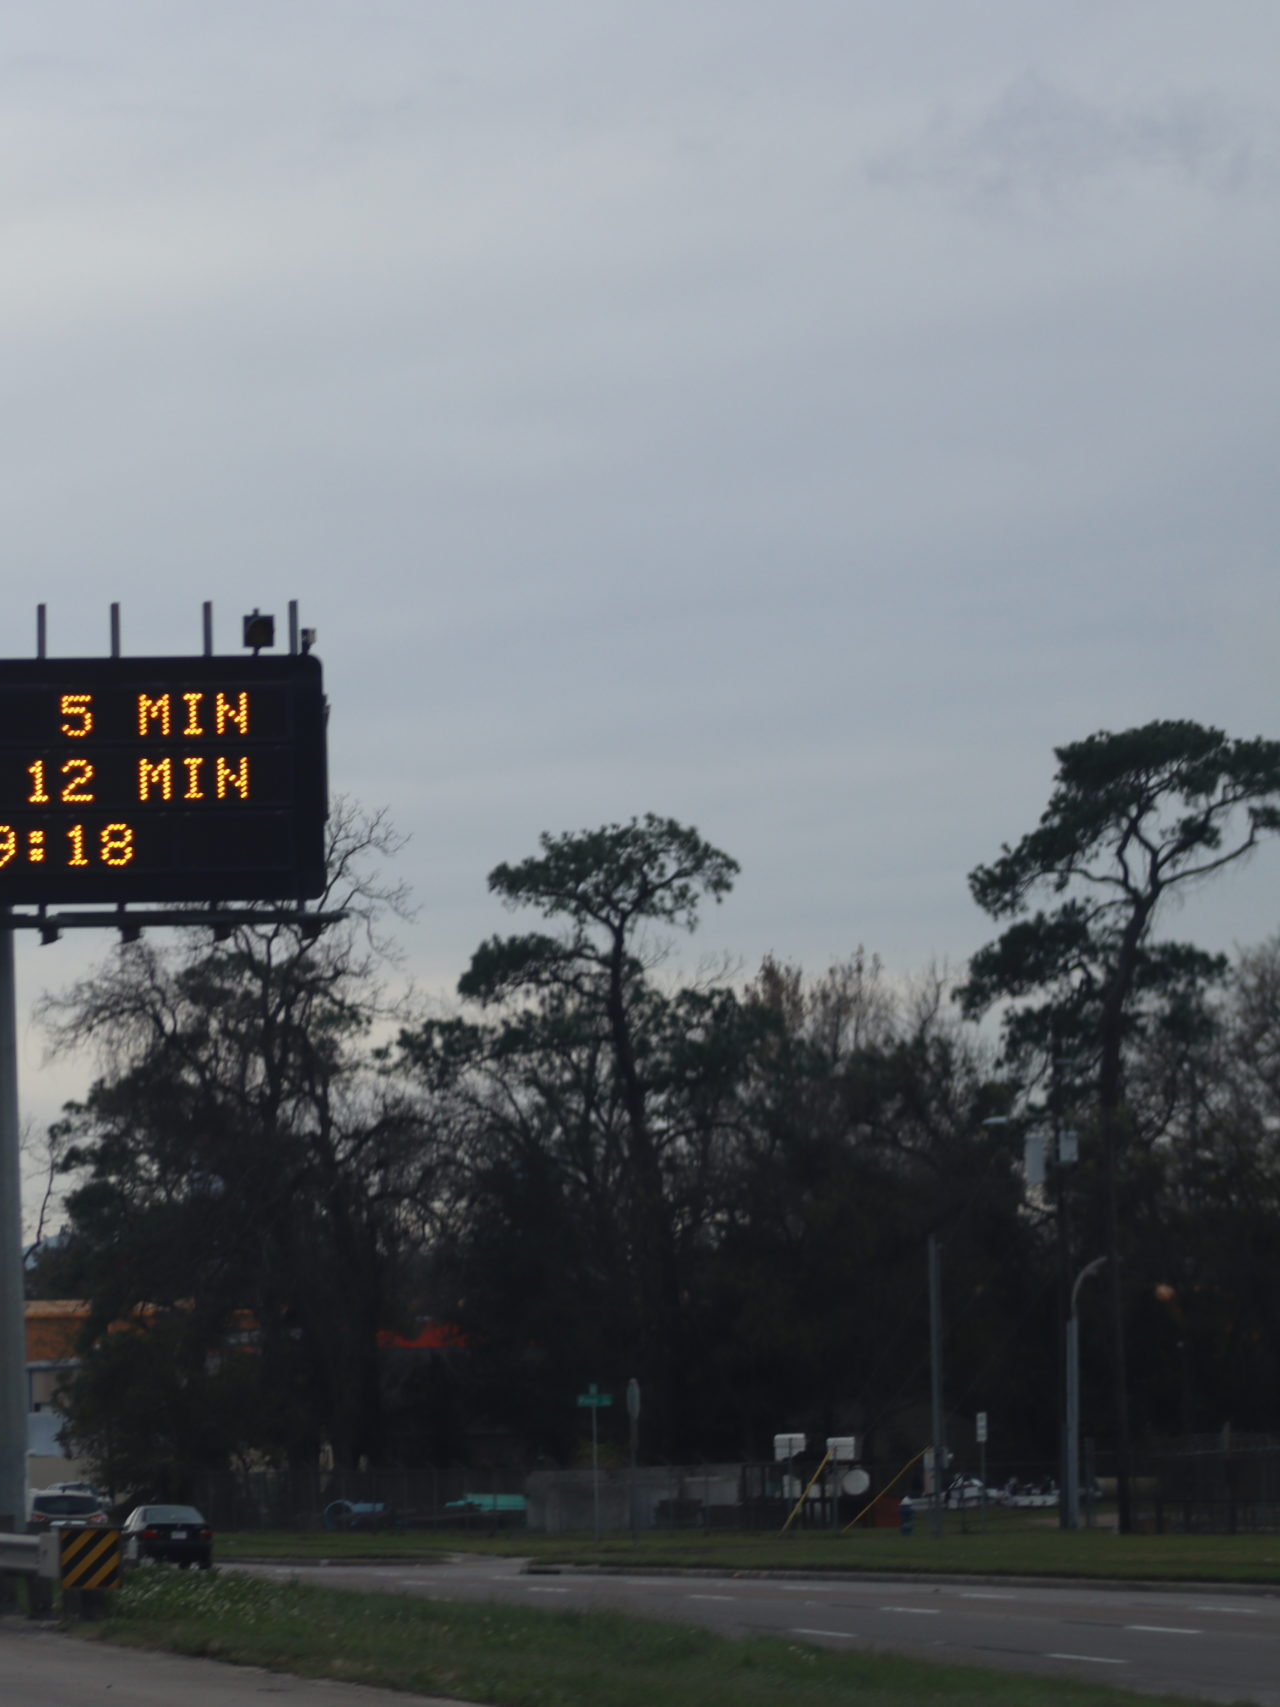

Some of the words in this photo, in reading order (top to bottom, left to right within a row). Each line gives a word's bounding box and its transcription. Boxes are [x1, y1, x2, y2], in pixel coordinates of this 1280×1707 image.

[61, 694, 93, 737] 5
[138, 691, 249, 736] MIN
[27, 759, 94, 803] 12
[139, 756, 250, 801] MIN
